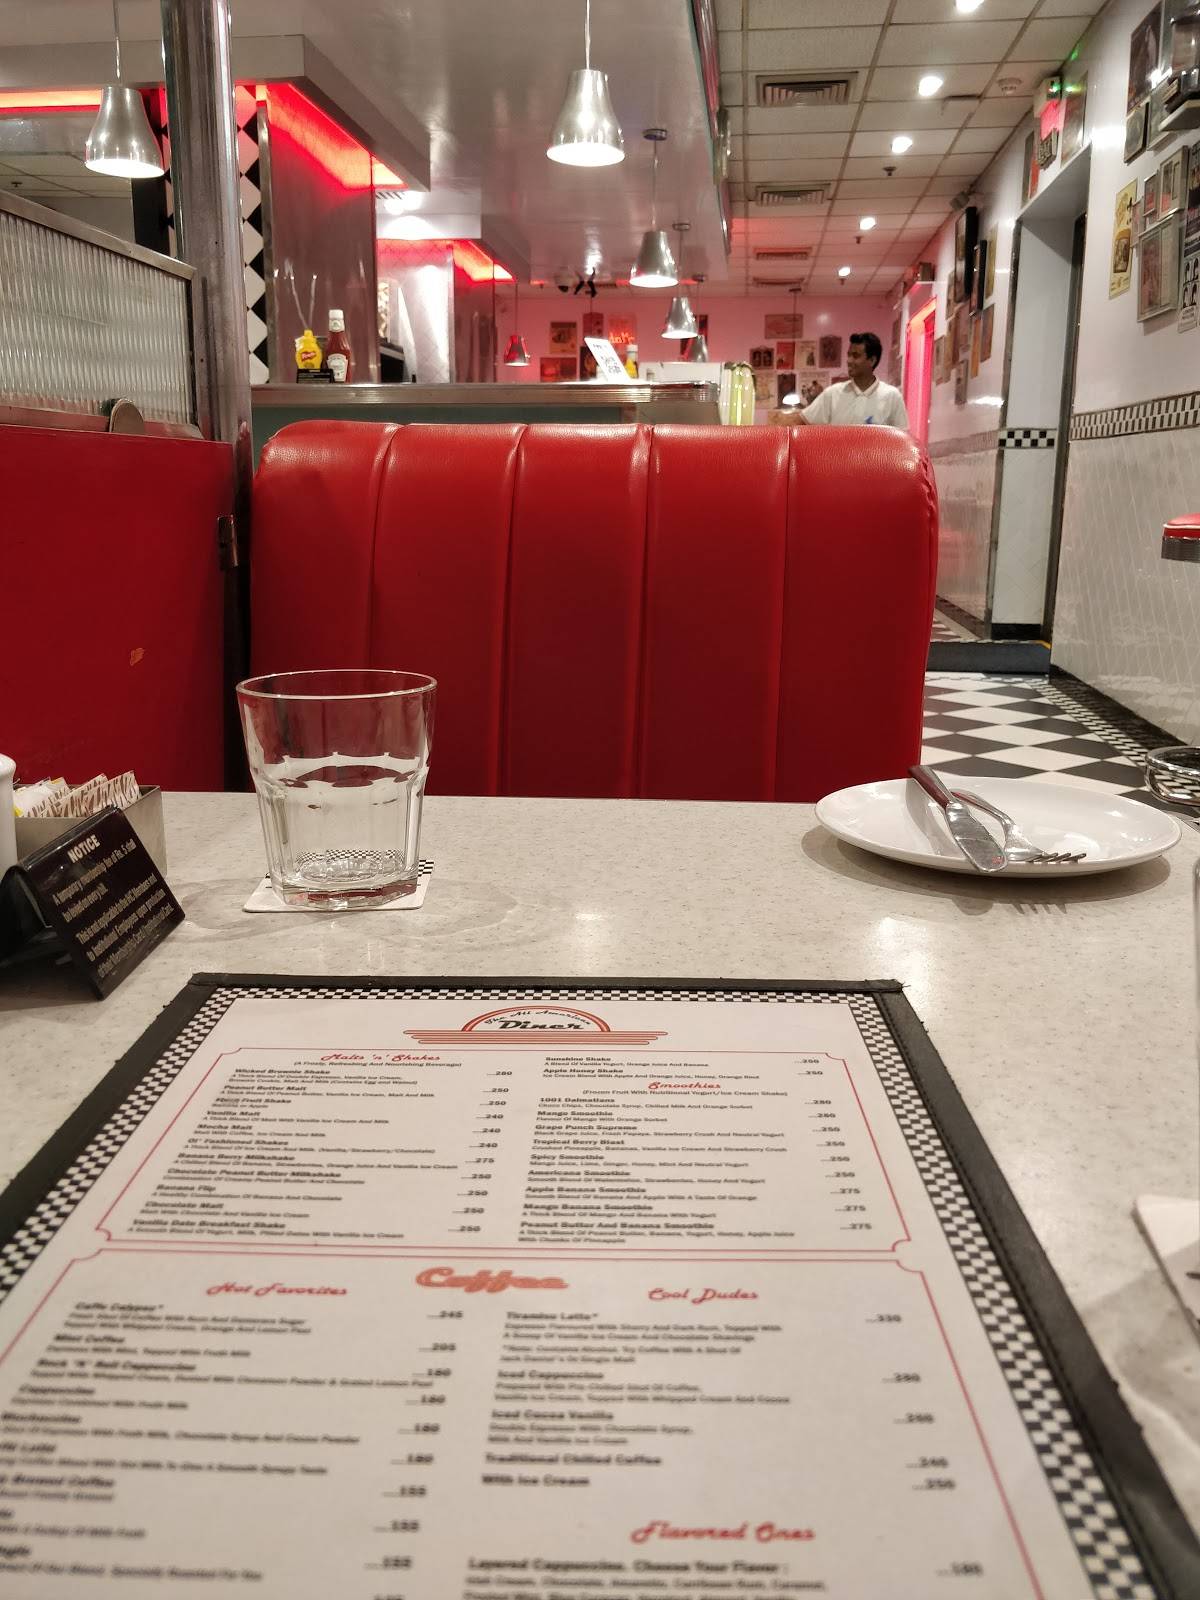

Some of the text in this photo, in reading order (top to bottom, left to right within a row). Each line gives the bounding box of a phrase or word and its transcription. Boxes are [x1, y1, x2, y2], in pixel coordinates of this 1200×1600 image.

[67, 834, 100, 864] NOTICE
[52, 894, 61, 906] A
[111, 851, 117, 863] of
[121, 844, 127, 855] 5
[500, 1020, 583, 1029] Diner
[321, 1053, 364, 1061] Malts
[391, 1054, 440, 1062] Shakes
[649, 1081, 720, 1089] Smoothies
[415, 1266, 569, 1293] Coffee
[207, 1282, 347, 1297] Hot Favorites
[649, 1287, 758, 1304] Cool Dudes
[529, 1371, 603, 1379] Cappuccino
[616, 1455, 661, 1465] Coffee
[543, 1475, 589, 1485] Cream
[631, 1520, 815, 1544] Flavored Ones
